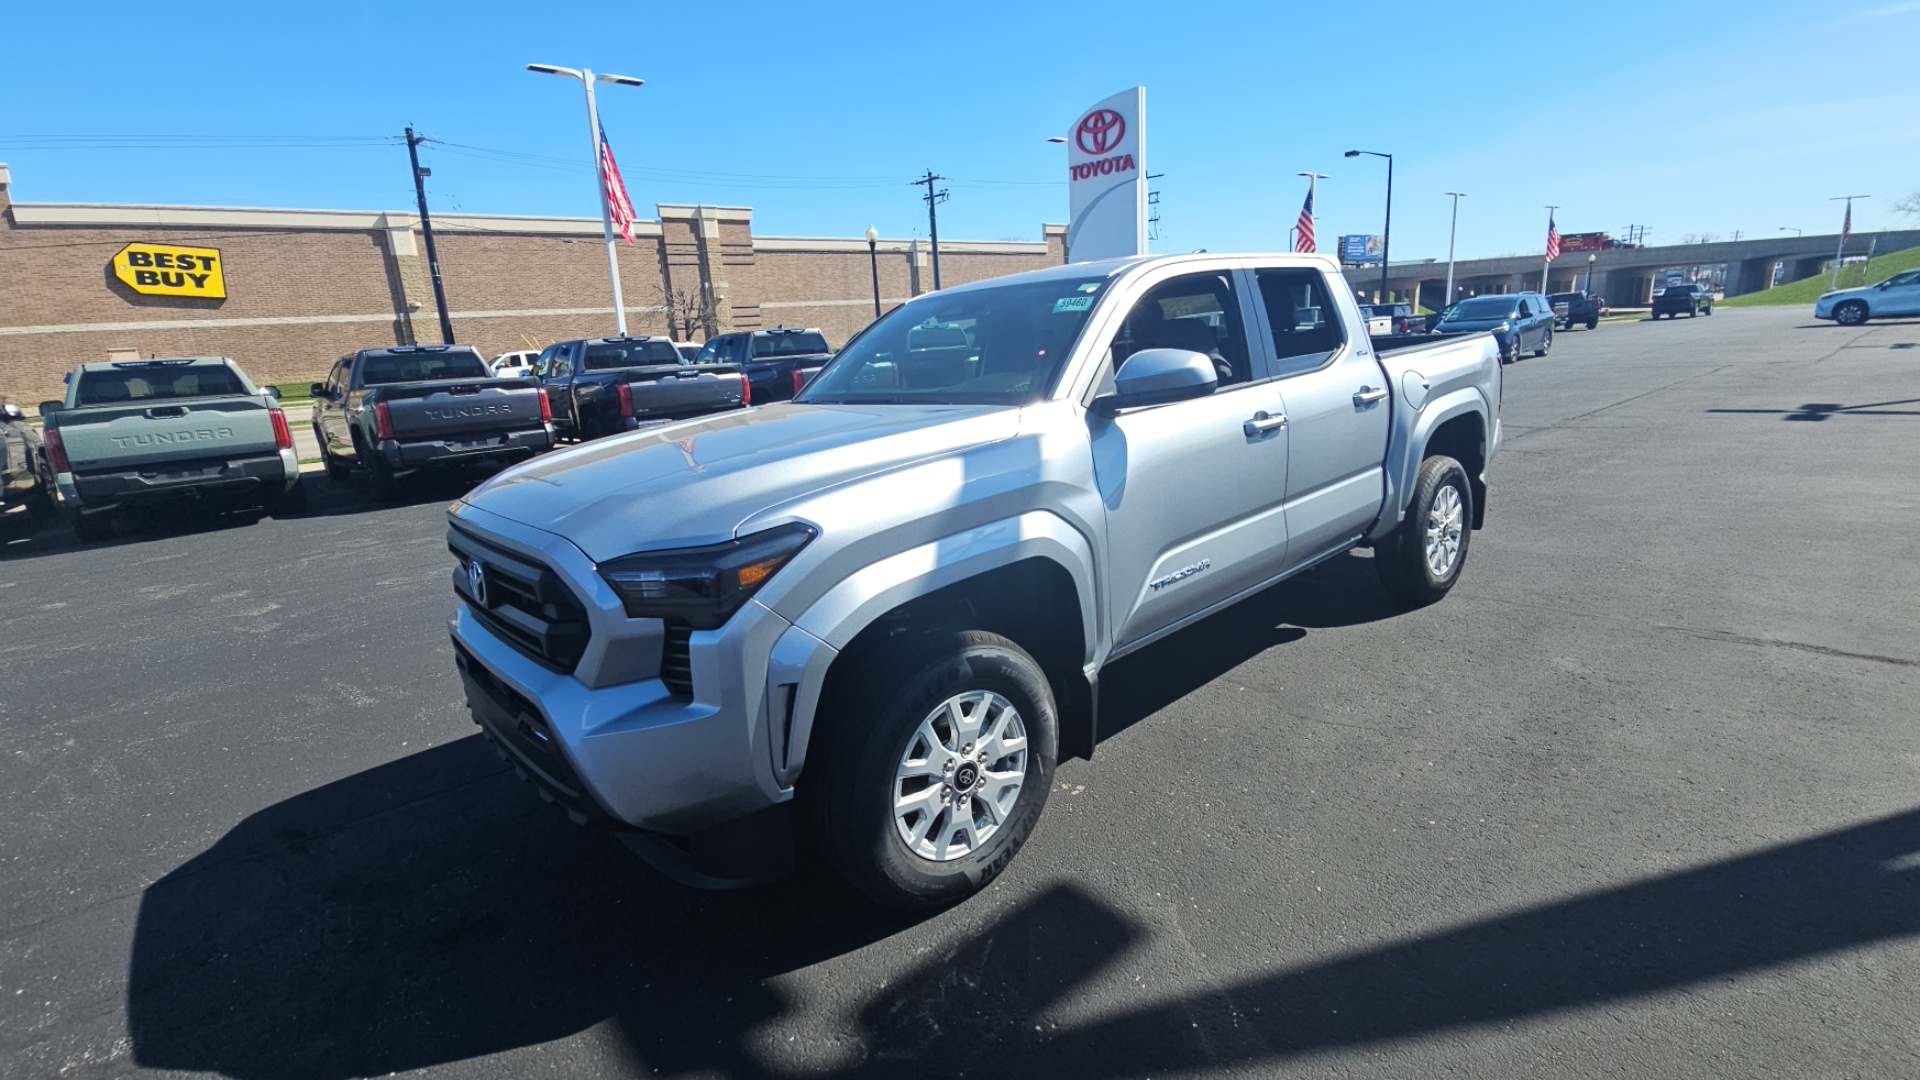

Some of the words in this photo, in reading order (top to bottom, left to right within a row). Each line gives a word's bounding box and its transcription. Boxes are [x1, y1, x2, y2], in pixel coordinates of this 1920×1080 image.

[1070, 153, 1135, 181] TOYOTA
[127, 251, 216, 271] BEST
[135, 270, 210, 288] BUY
[1060, 298, 1088, 307] 59460
[425, 405, 512, 420] TUNDRA
[111, 427, 233, 448] TUNDRA
